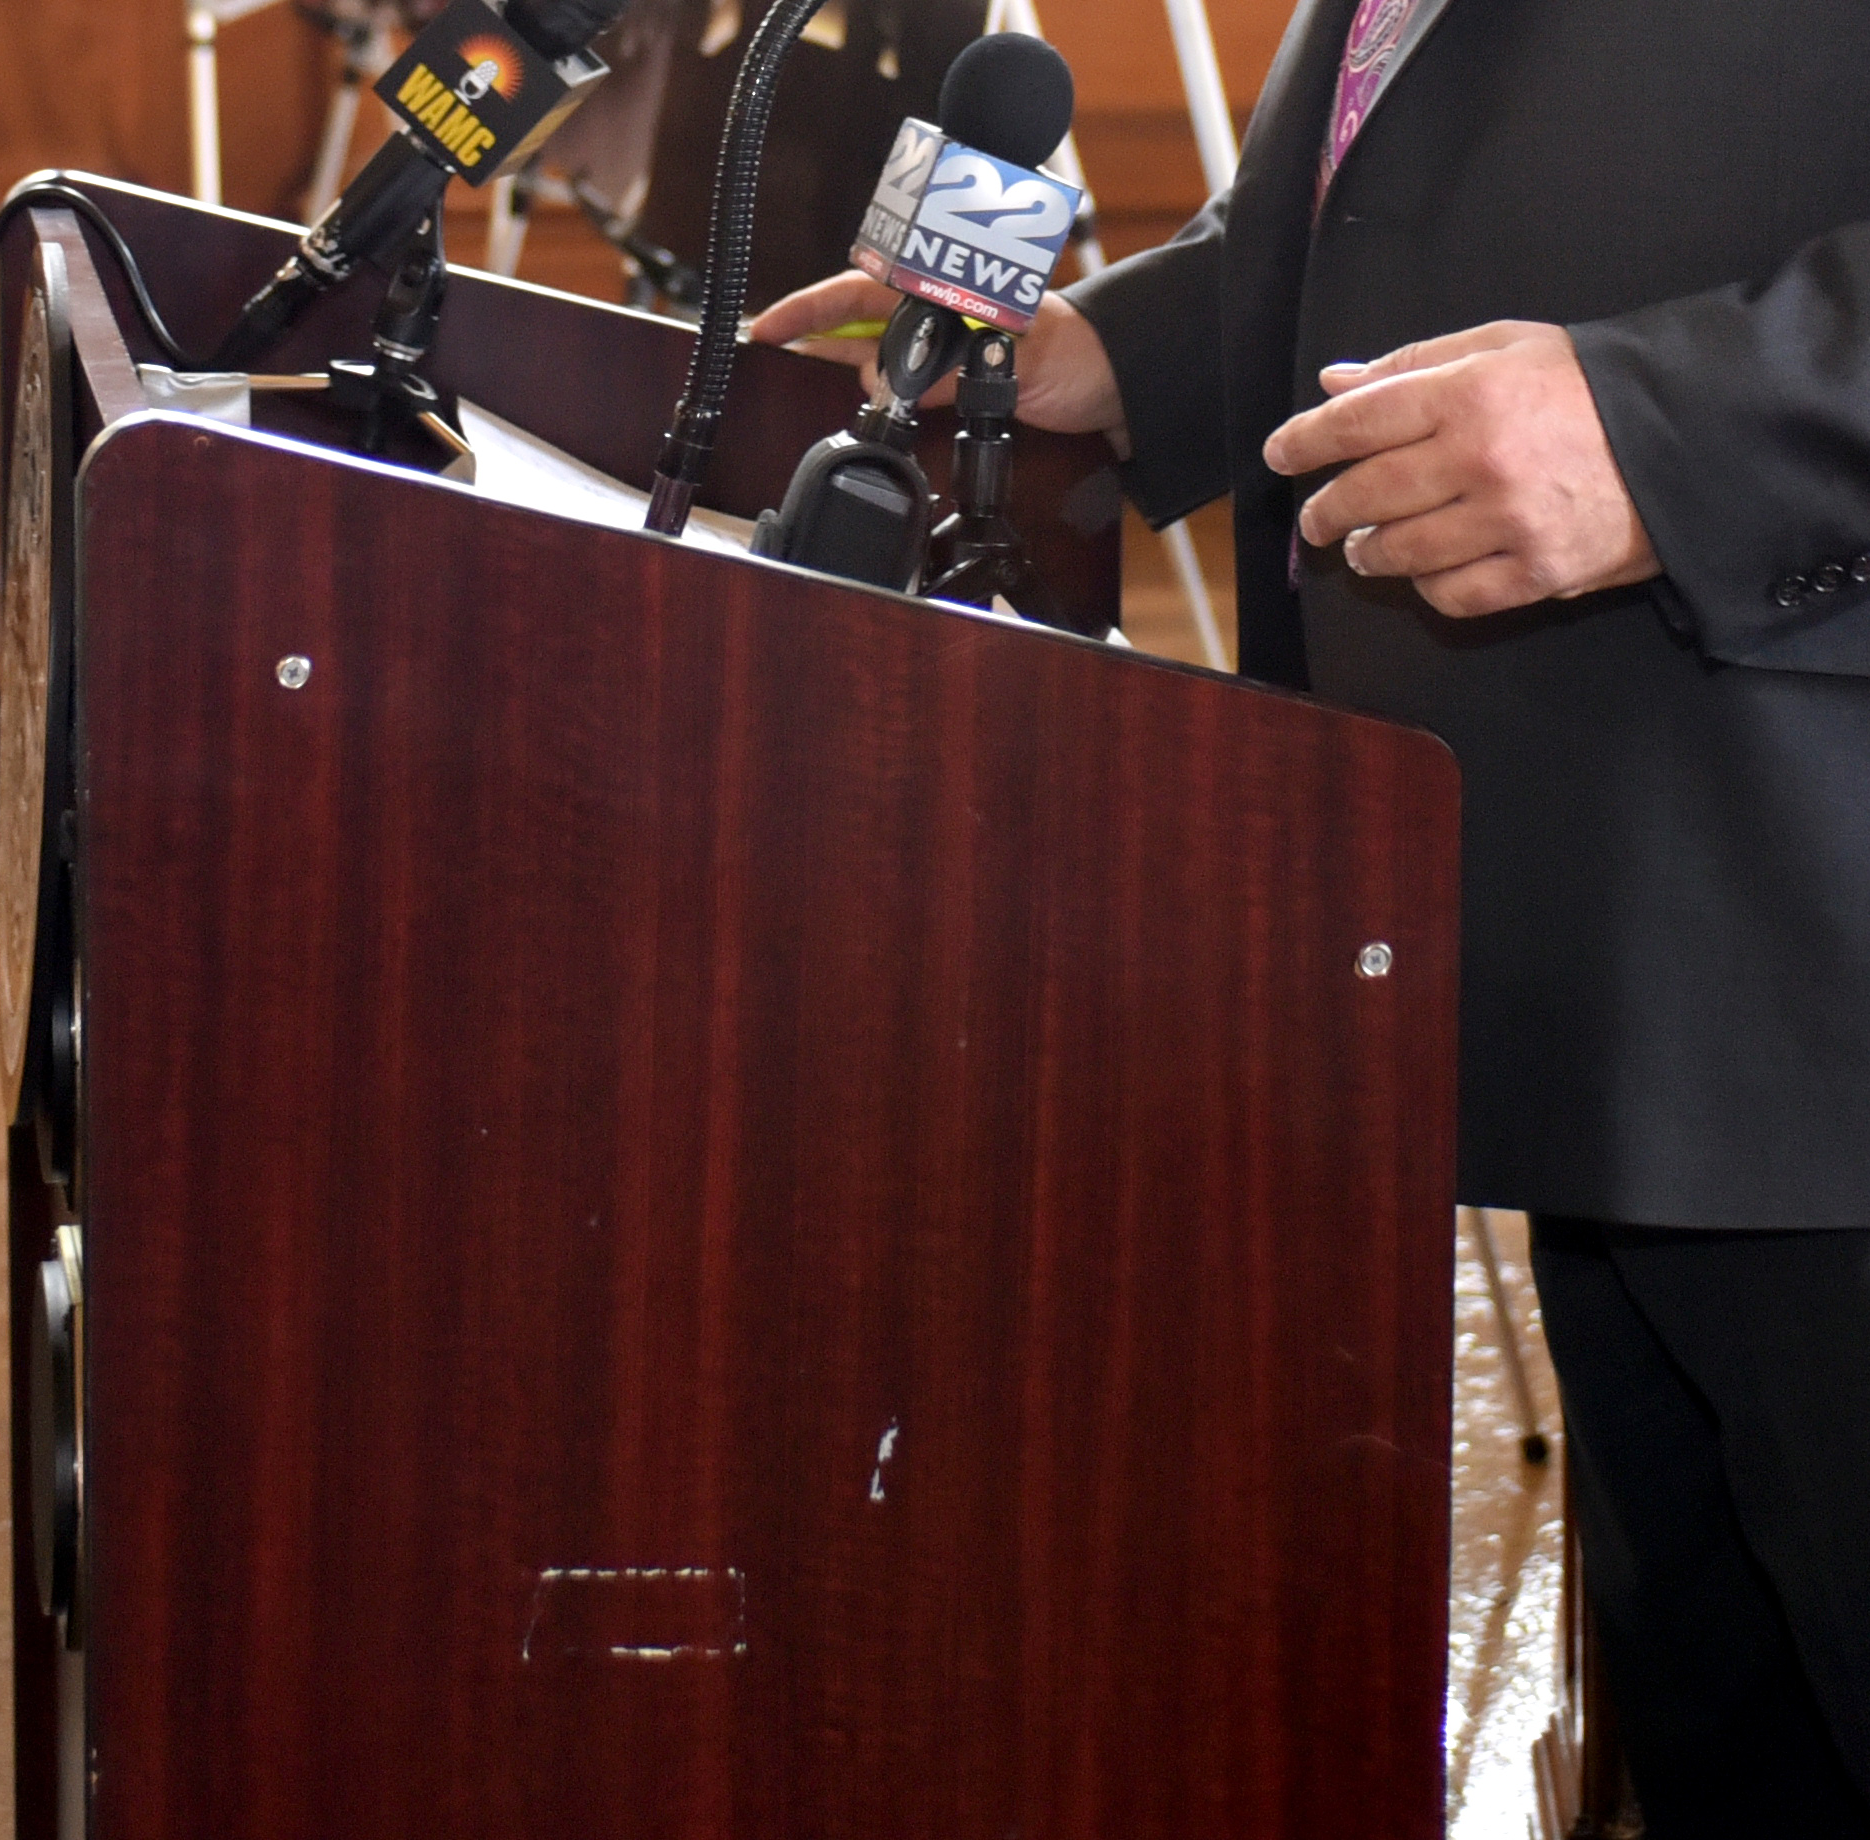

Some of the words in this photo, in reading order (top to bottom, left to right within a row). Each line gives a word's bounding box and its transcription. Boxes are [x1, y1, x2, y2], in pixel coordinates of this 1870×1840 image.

[396, 63, 496, 167] WAMC
[873, 126, 935, 222] 22
[916, 154, 1070, 274] 22
[900, 228, 1044, 305] NEWS
[919, 280, 999, 319] wwlp.com
